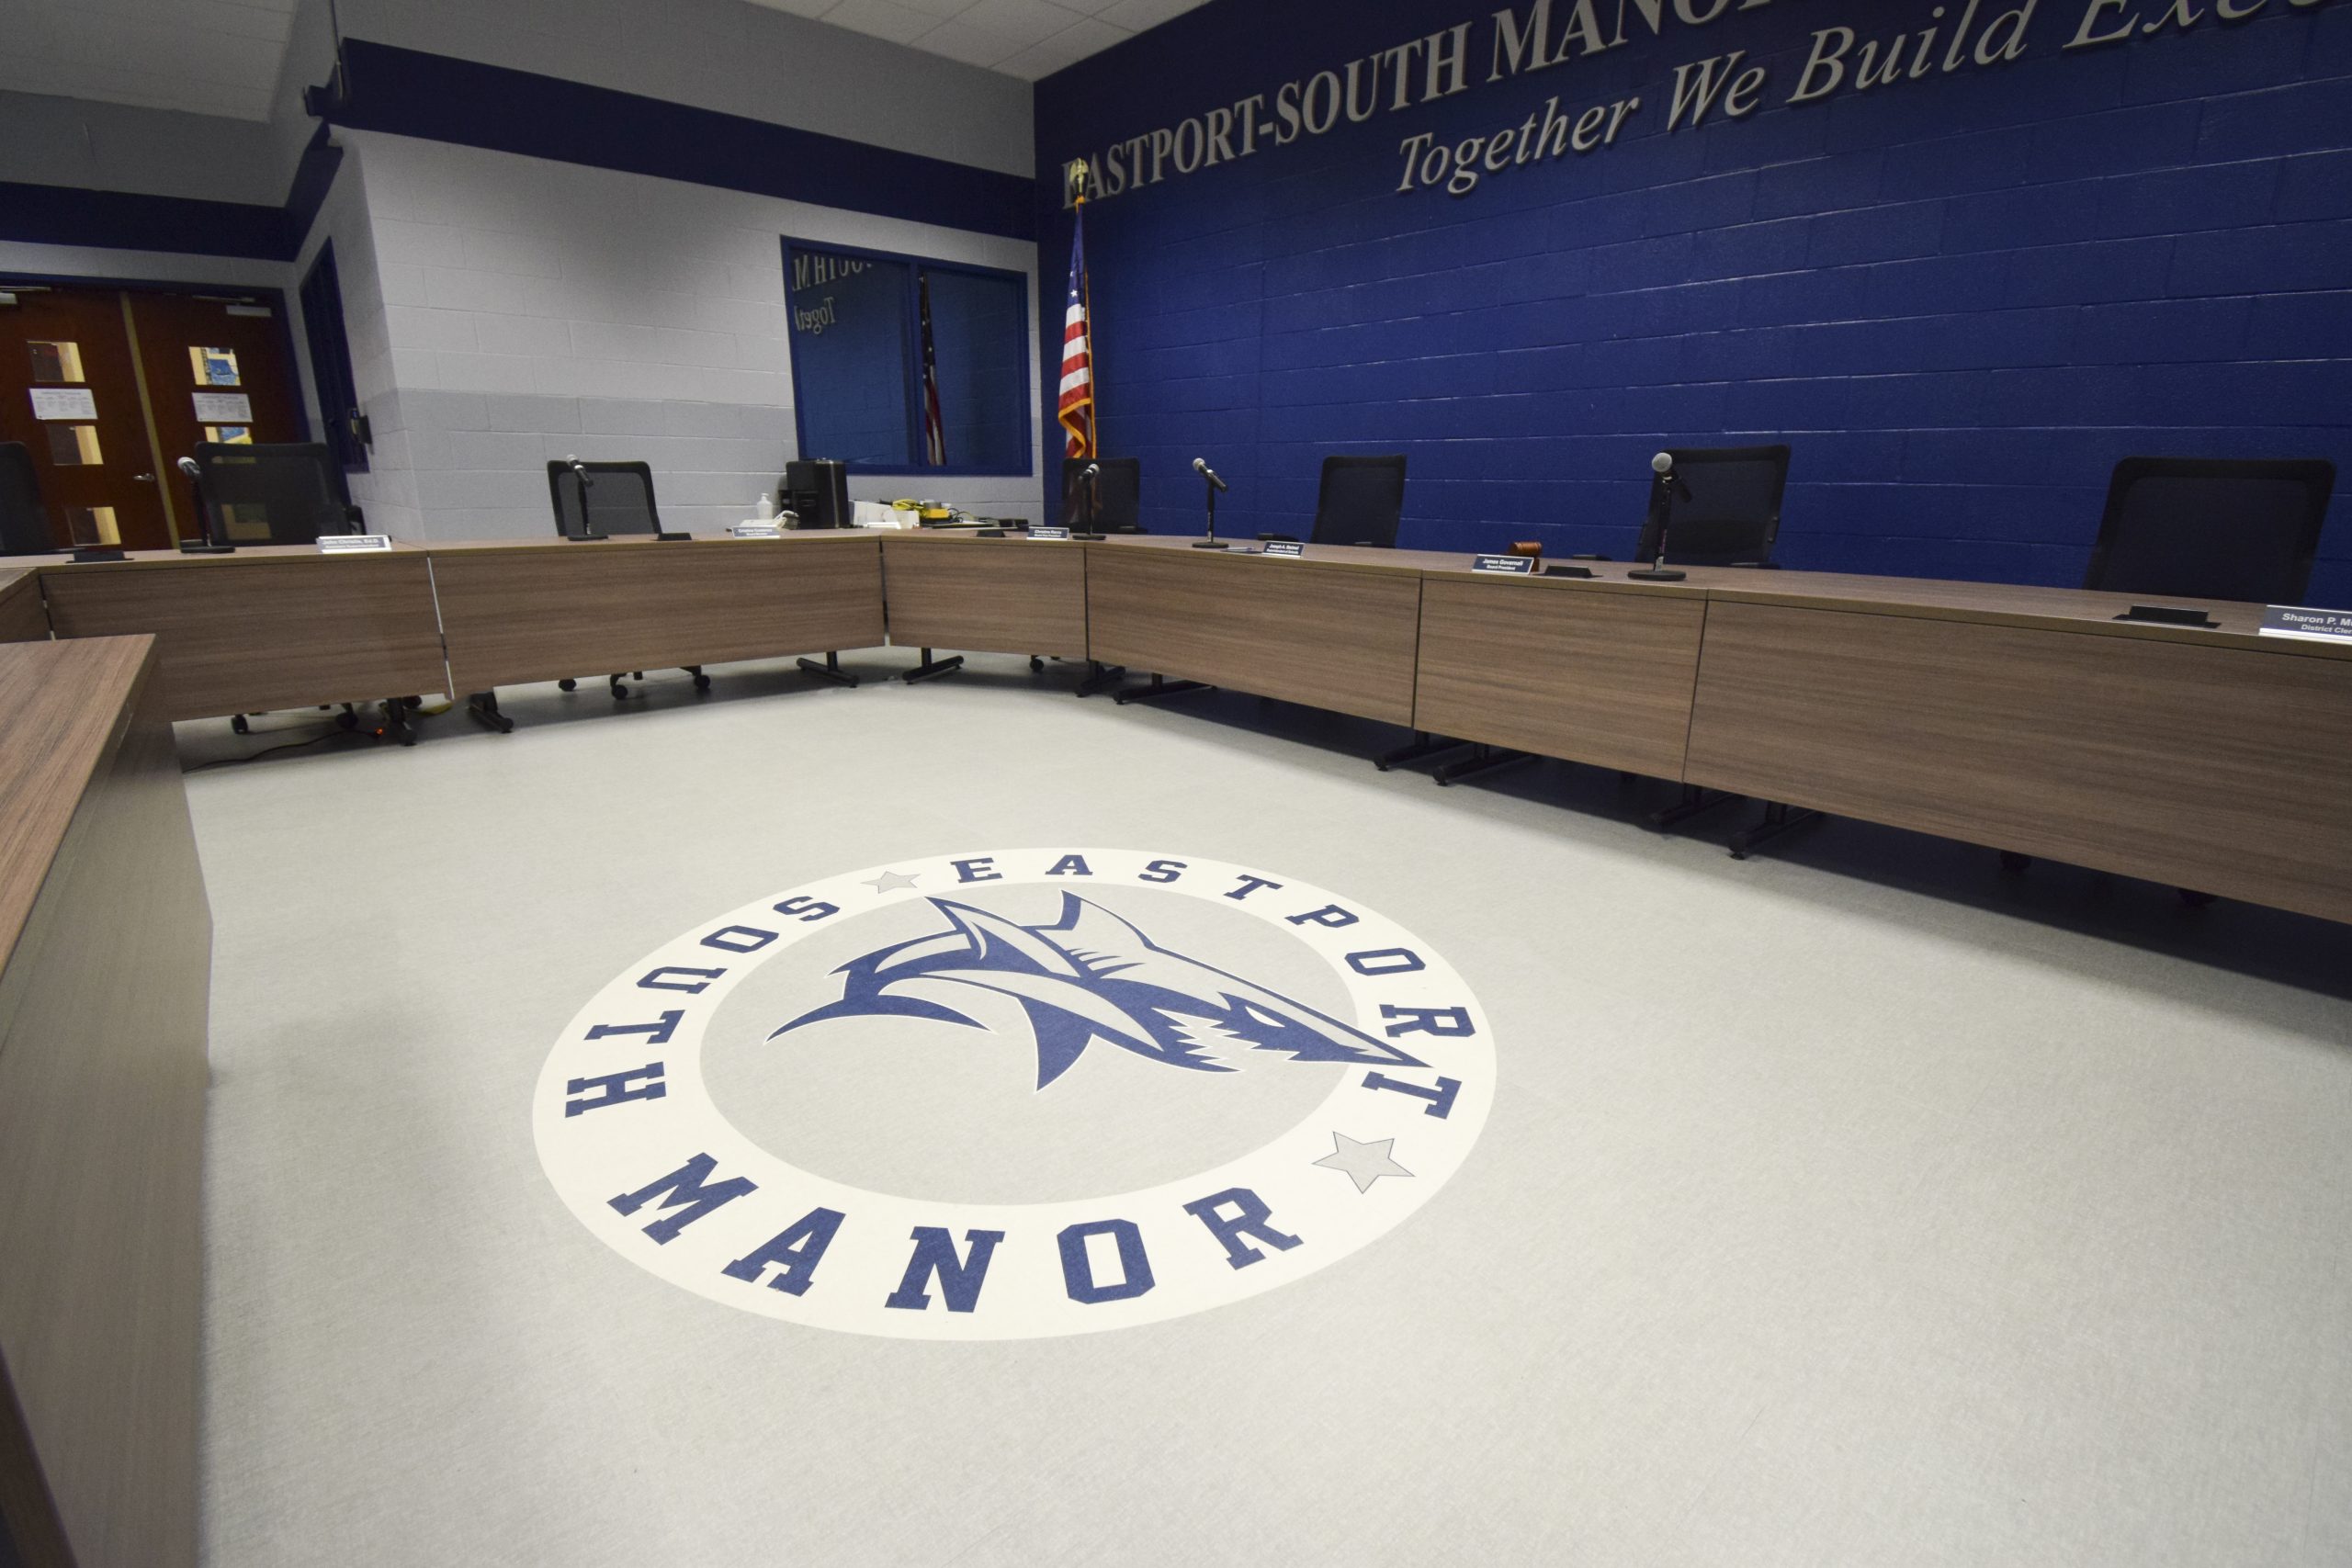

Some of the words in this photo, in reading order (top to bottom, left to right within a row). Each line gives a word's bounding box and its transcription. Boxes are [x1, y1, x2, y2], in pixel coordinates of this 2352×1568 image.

[1396, 96, 1641, 195] Together
[1665, 51, 1765, 132] We
[1785, 0, 2029, 105] Build
[1486, 0, 1771, 81] MAN
[2282, 613, 2324, 624] Sharon
[2327, 616, 2336, 626] P.
[2301, 624, 2333, 633] District
[565, 896, 840, 1118] SOUTH
[950, 853, 1476, 1120] EASTPORT
[606, 1152, 1304, 1314] MANOR
